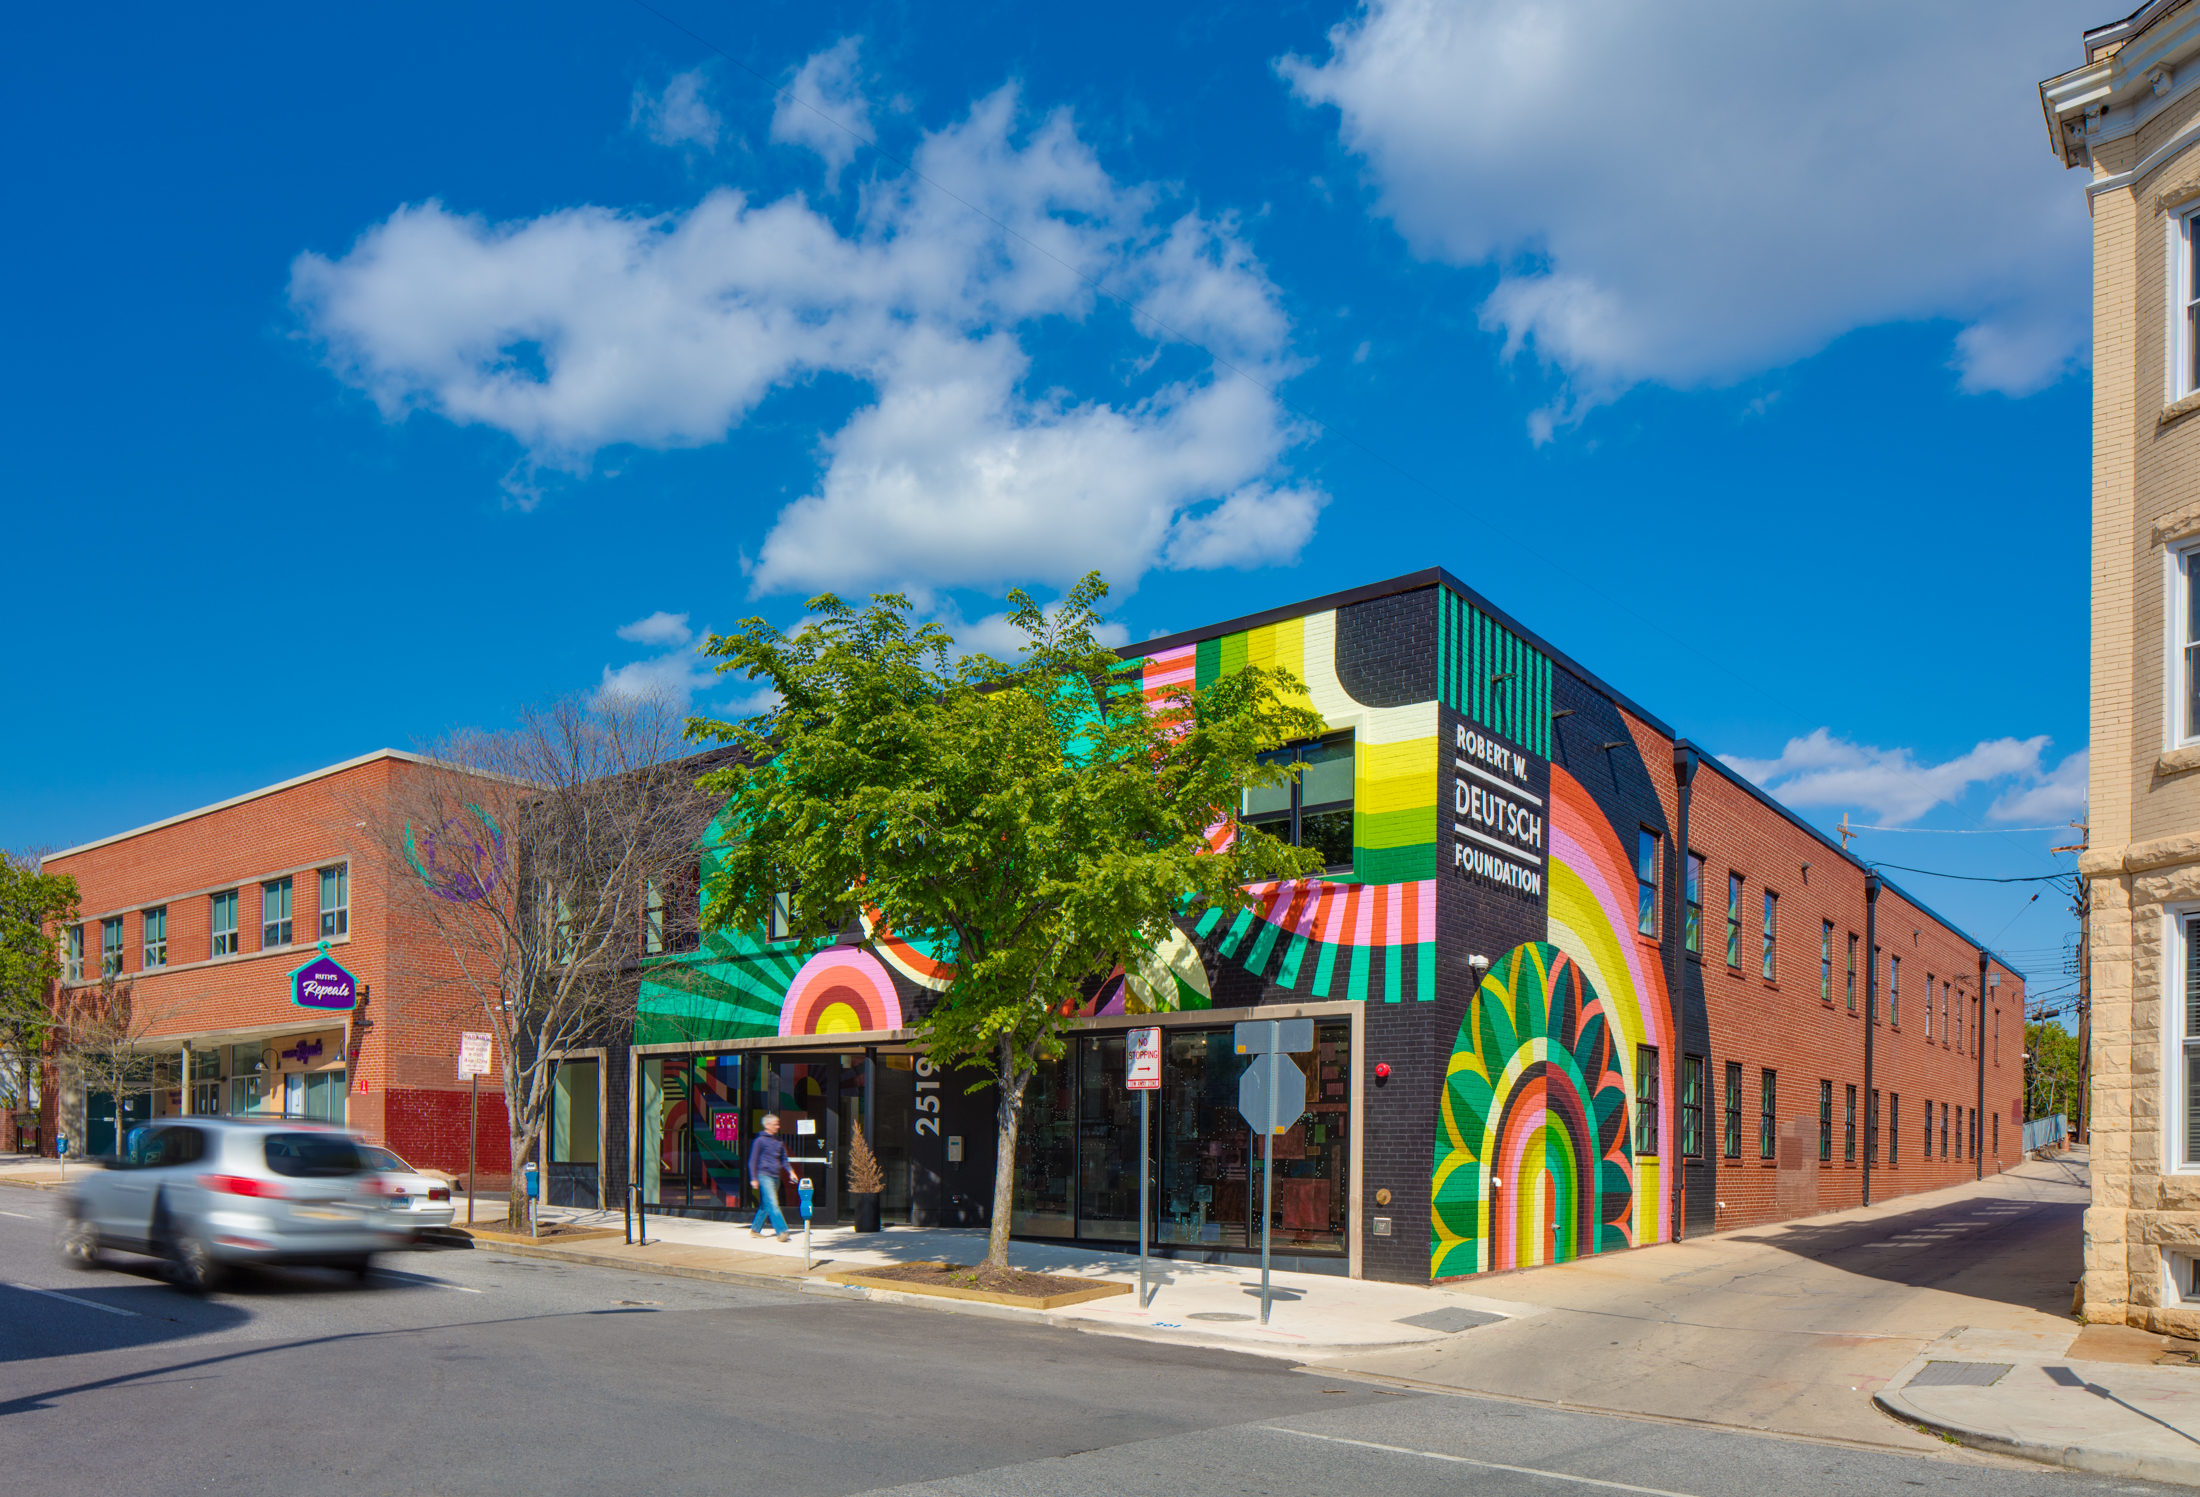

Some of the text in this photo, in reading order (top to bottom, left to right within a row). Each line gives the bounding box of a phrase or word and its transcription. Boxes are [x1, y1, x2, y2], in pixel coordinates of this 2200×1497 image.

[1456, 724, 1528, 781] ROBERT W.
[1455, 778, 1541, 848] DEUTSCH
[1455, 842, 1541, 896] FOUNDATION
[302, 980, 350, 1000] Repeats
[314, 973, 338, 981] RUTH'S
[1128, 1050, 1158, 1060] STOPPING
[1138, 1037, 1148, 1047] NO
[915, 1057, 940, 1136] 2519
